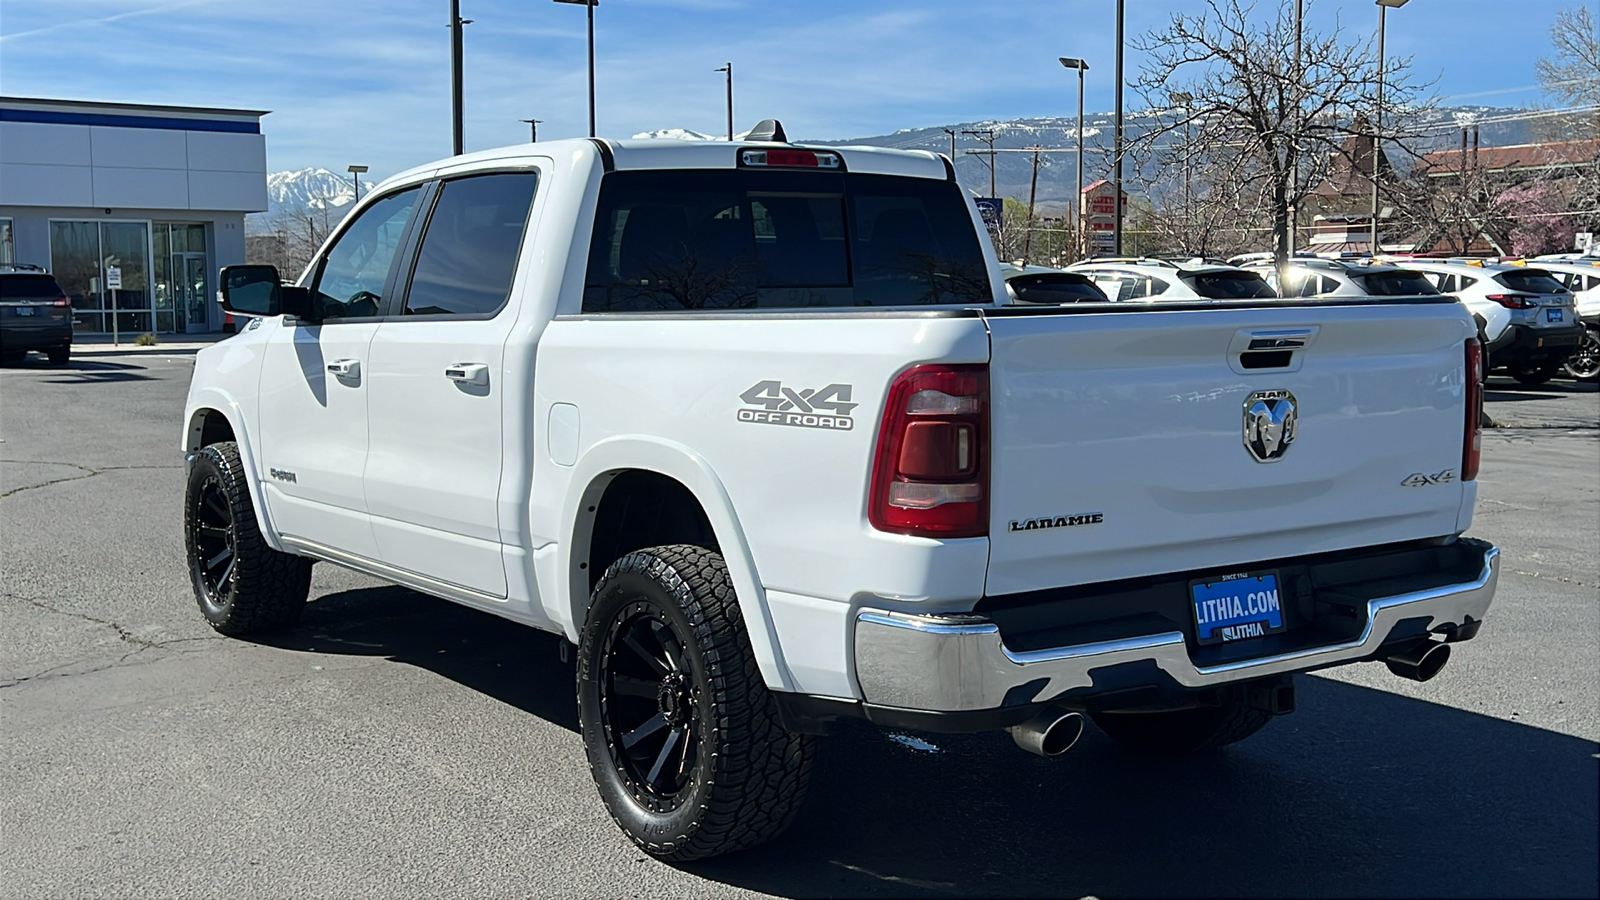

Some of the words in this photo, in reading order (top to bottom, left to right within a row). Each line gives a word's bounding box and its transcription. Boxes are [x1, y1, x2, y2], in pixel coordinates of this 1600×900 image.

[1256, 391, 1287, 399] RAM
[738, 410, 782, 423] OFF
[786, 414, 852, 429] ROAD
[1010, 513, 1104, 532] LARAMIE
[1222, 573, 1237, 581] SINCE
[1195, 589, 1280, 624] LITHIA.COM
[1231, 622, 1264, 640] LITHIA
